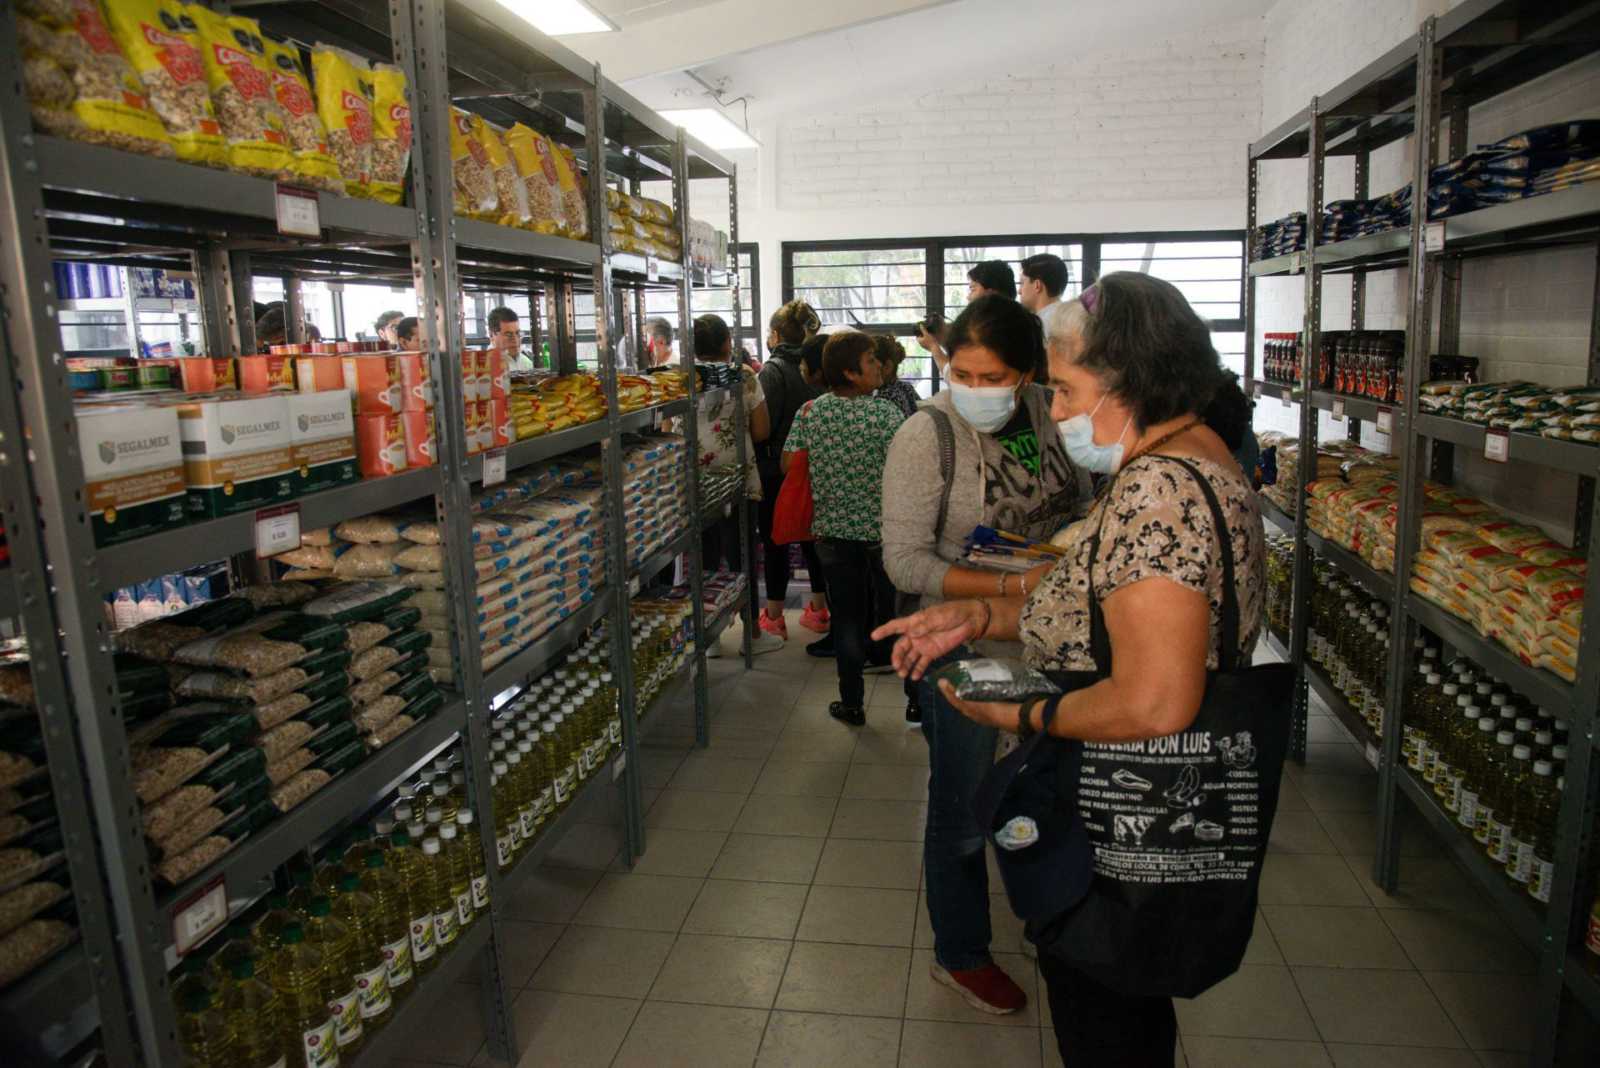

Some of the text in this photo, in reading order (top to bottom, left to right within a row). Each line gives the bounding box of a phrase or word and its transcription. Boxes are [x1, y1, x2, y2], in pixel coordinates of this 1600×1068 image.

[310, 412, 345, 424] SEGALMEX
[236, 420, 280, 435] SEGALMEX
[117, 435, 170, 453] SEGALMEX
[1148, 735, 1180, 755] DON
[1183, 731, 1211, 754] LUIS
[1101, 790, 1144, 801] ARGENTINO
[1134, 862, 1157, 870] LOCAL
[1119, 873, 1140, 882] DON
[1163, 874, 1205, 883] MERCADO
[1207, 872, 1248, 881] MORELOS
